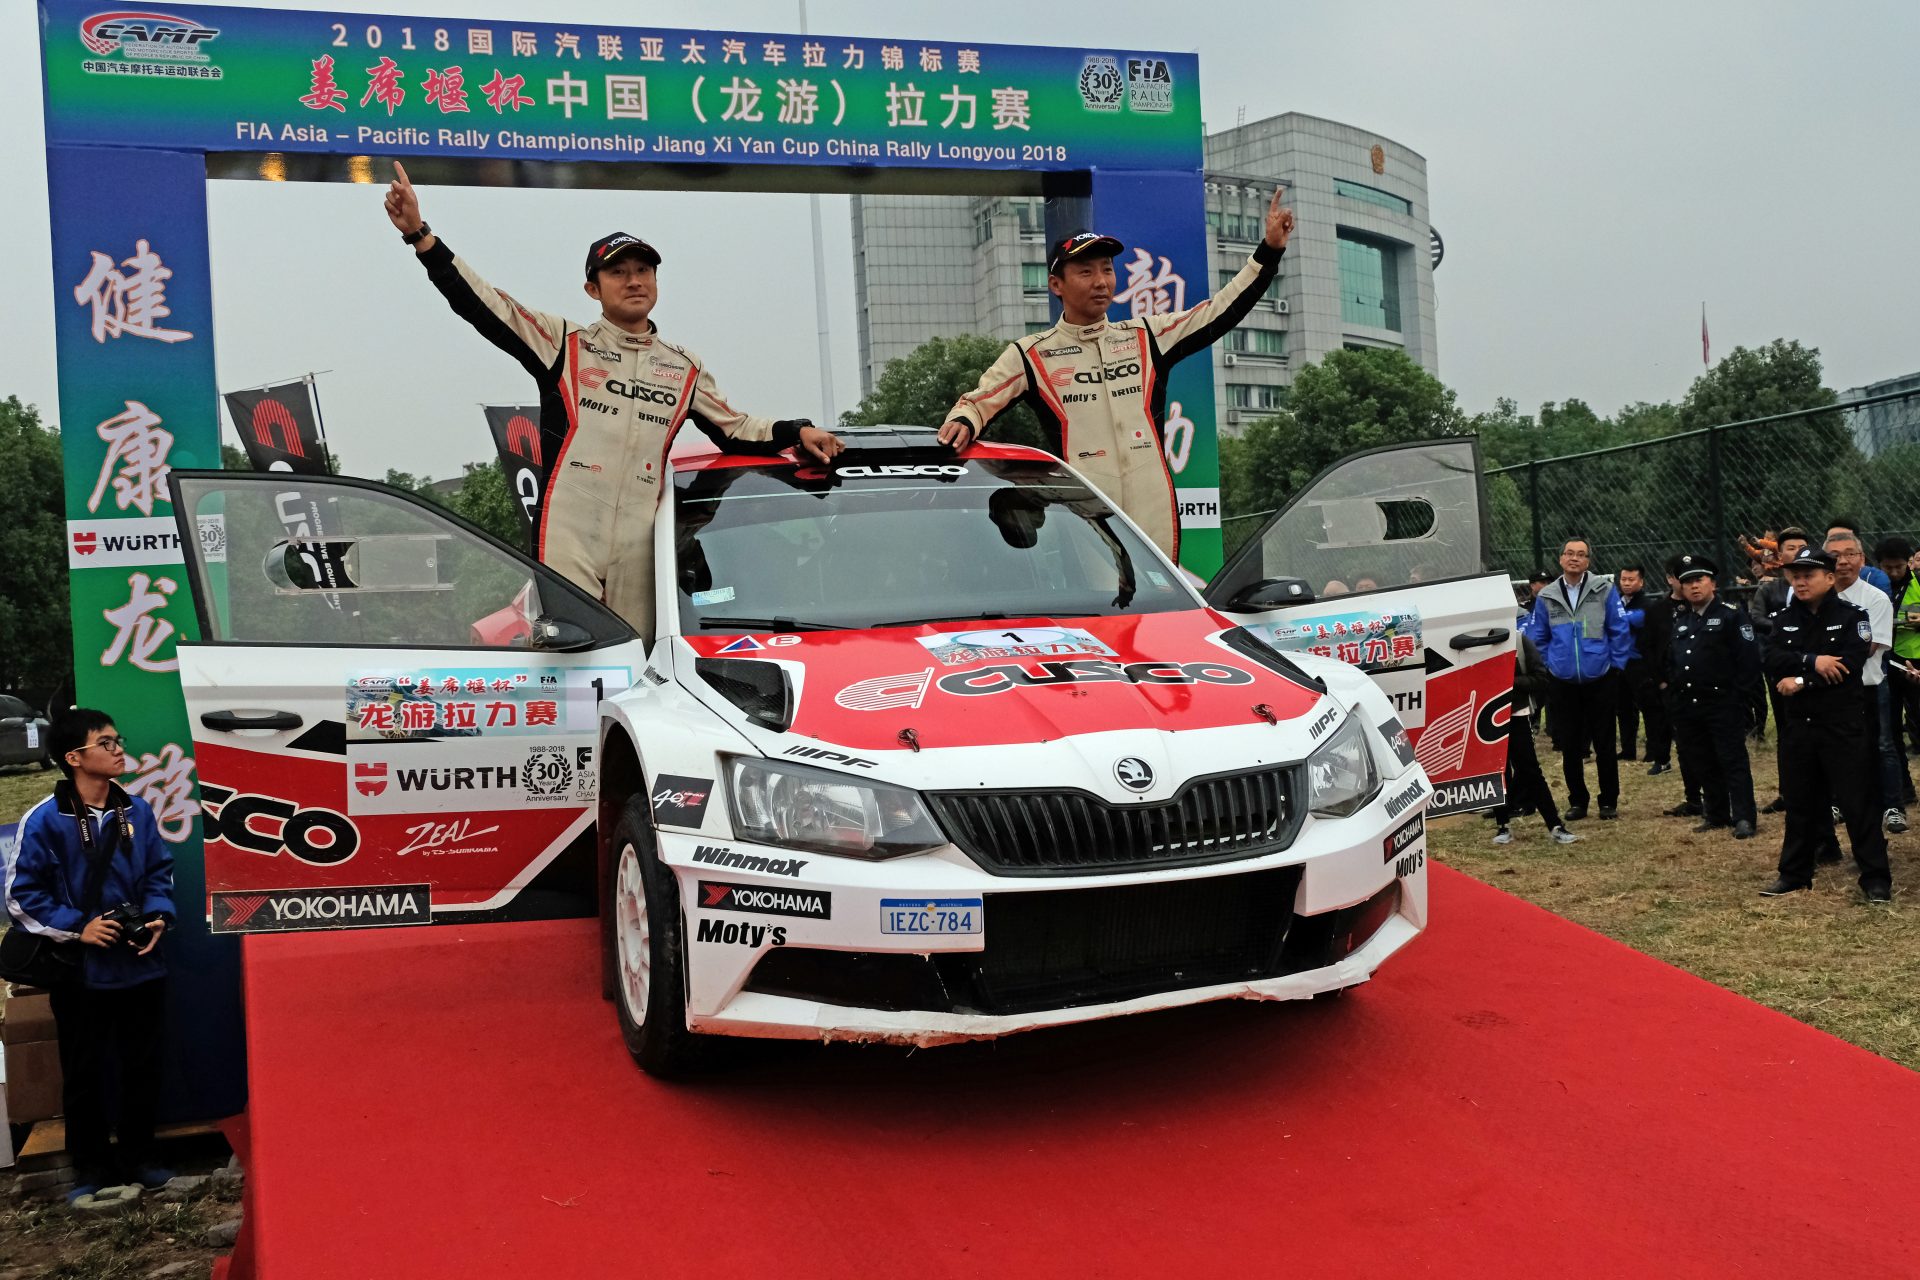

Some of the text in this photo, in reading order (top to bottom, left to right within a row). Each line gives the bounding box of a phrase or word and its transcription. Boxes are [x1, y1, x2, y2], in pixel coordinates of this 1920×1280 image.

[96, 24, 219, 44] CAMF
[83, 61, 221, 78] 中国汽车摩托车运动联合会
[1092, 73, 1112, 89] 30
[1131, 90, 1170, 101] RALLY
[1085, 103, 1120, 111] Anniversary
[236, 121, 273, 141] FIA
[280, 123, 329, 142] Asia
[357, 125, 430, 146] Pacific
[438, 128, 490, 149] Rally
[497, 130, 646, 154] Championship
[652, 135, 706, 156] Jiang
[713, 136, 732, 153] Xi
[738, 136, 775, 154] Yan
[782, 137, 819, 157] Cup
[826, 139, 880, 157] China
[886, 140, 932, 160] Rally
[938, 142, 1016, 162] Longyou
[1022, 145, 1067, 162] 2018
[605, 379, 677, 407] CUSCO
[1062, 394, 1097, 404] Moty's
[1111, 385, 1143, 398] BRIDE
[579, 397, 619, 416] Moty's
[638, 411, 672, 427] BRIDE
[835, 465, 969, 477] CUSCO
[324, 563, 342, 611] EQUIPENT
[1001, 632, 1024, 643] 1
[936, 660, 1255, 696] CUSCO
[360, 700, 558, 730] 龙游拉力赛
[529, 745, 566, 753] 1988-2018
[397, 765, 517, 792] WÜRTH
[536, 762, 560, 780] 30
[80, 818, 90, 842] Canon
[397, 818, 500, 856] ZEAL
[1393, 818, 1422, 851] YOKOHAMA
[1396, 848, 1423, 878] Moty's
[269, 892, 420, 921] YOKOHAMA
[731, 889, 824, 914] YOKOHAMA
[697, 918, 787, 948] Moty's
